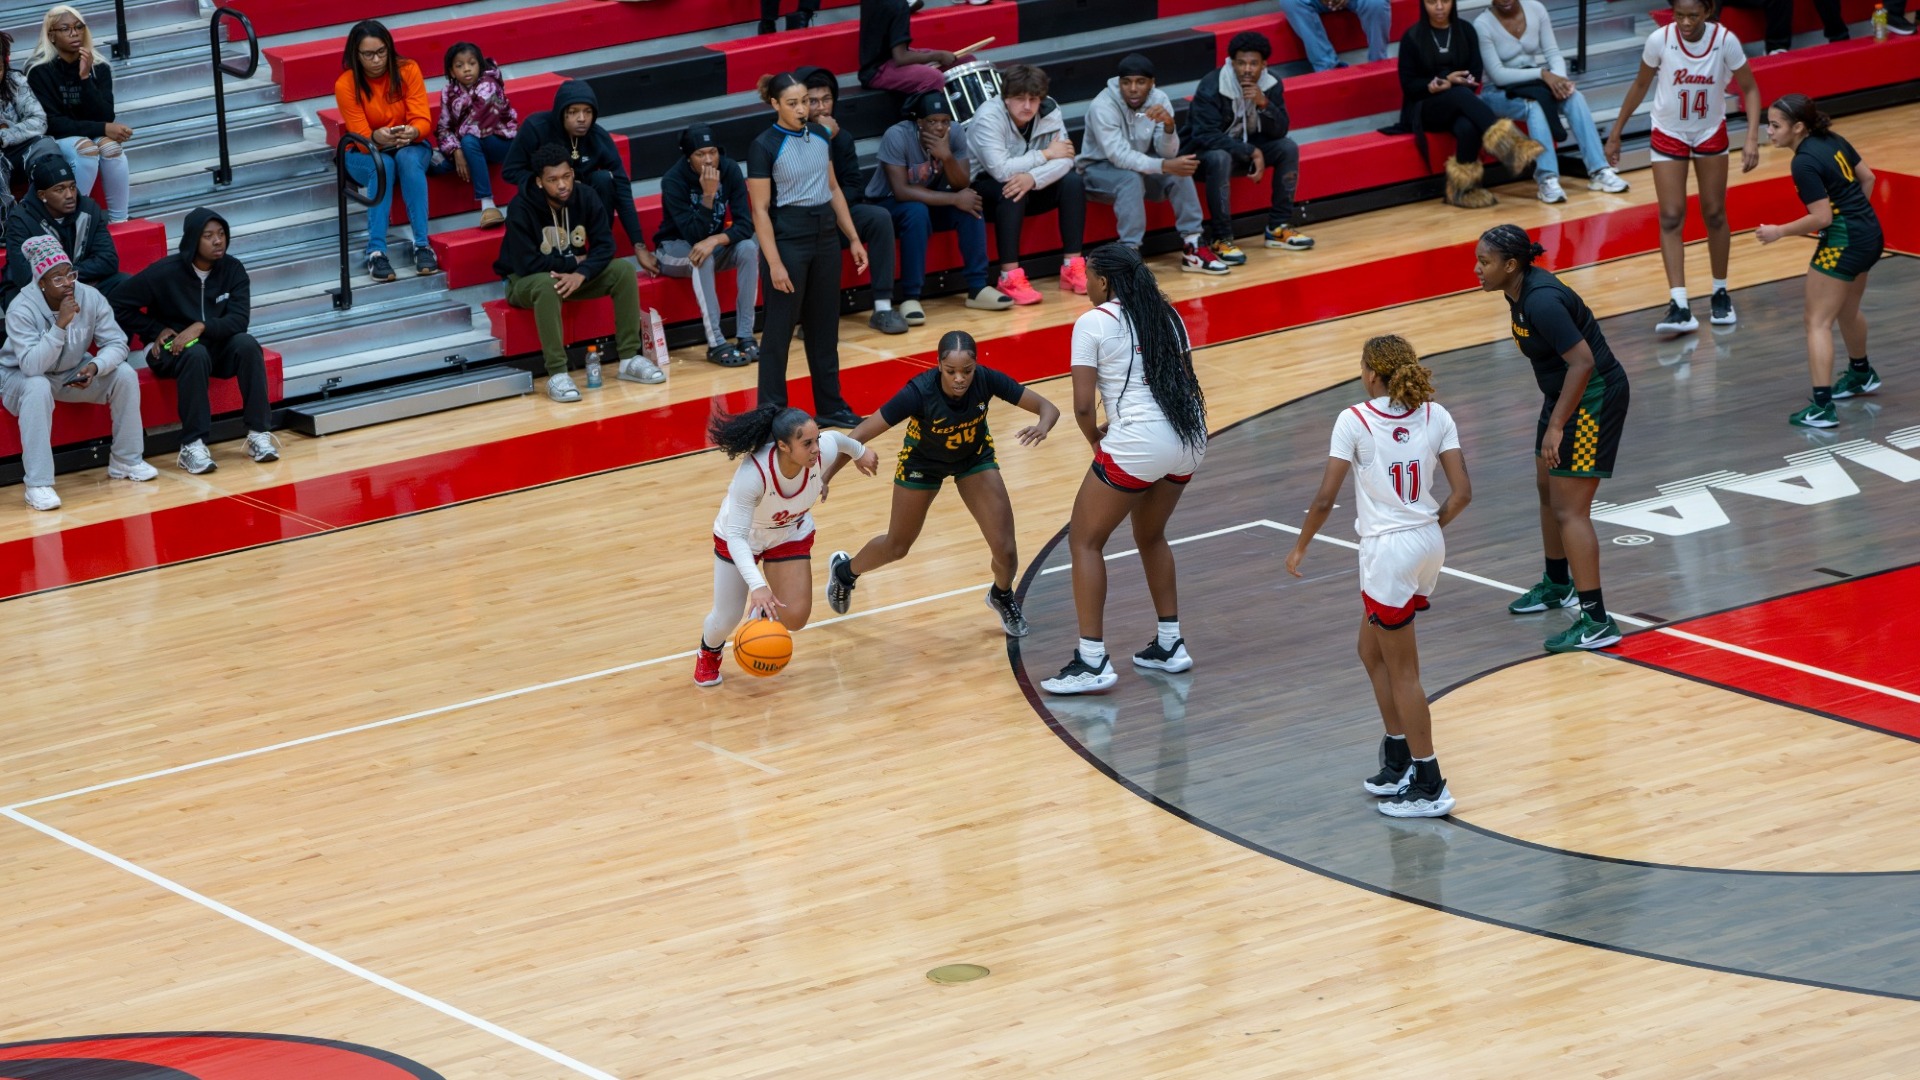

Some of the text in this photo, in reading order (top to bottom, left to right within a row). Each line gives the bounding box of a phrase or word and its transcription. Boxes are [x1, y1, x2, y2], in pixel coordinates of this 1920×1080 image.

[1673, 67, 1715, 85] Rams
[1678, 89, 1709, 120] 14
[591, 368, 599, 377] G
[945, 427, 976, 450] 24
[1388, 459, 1421, 505] 11
[1589, 424, 1920, 537] IAA
